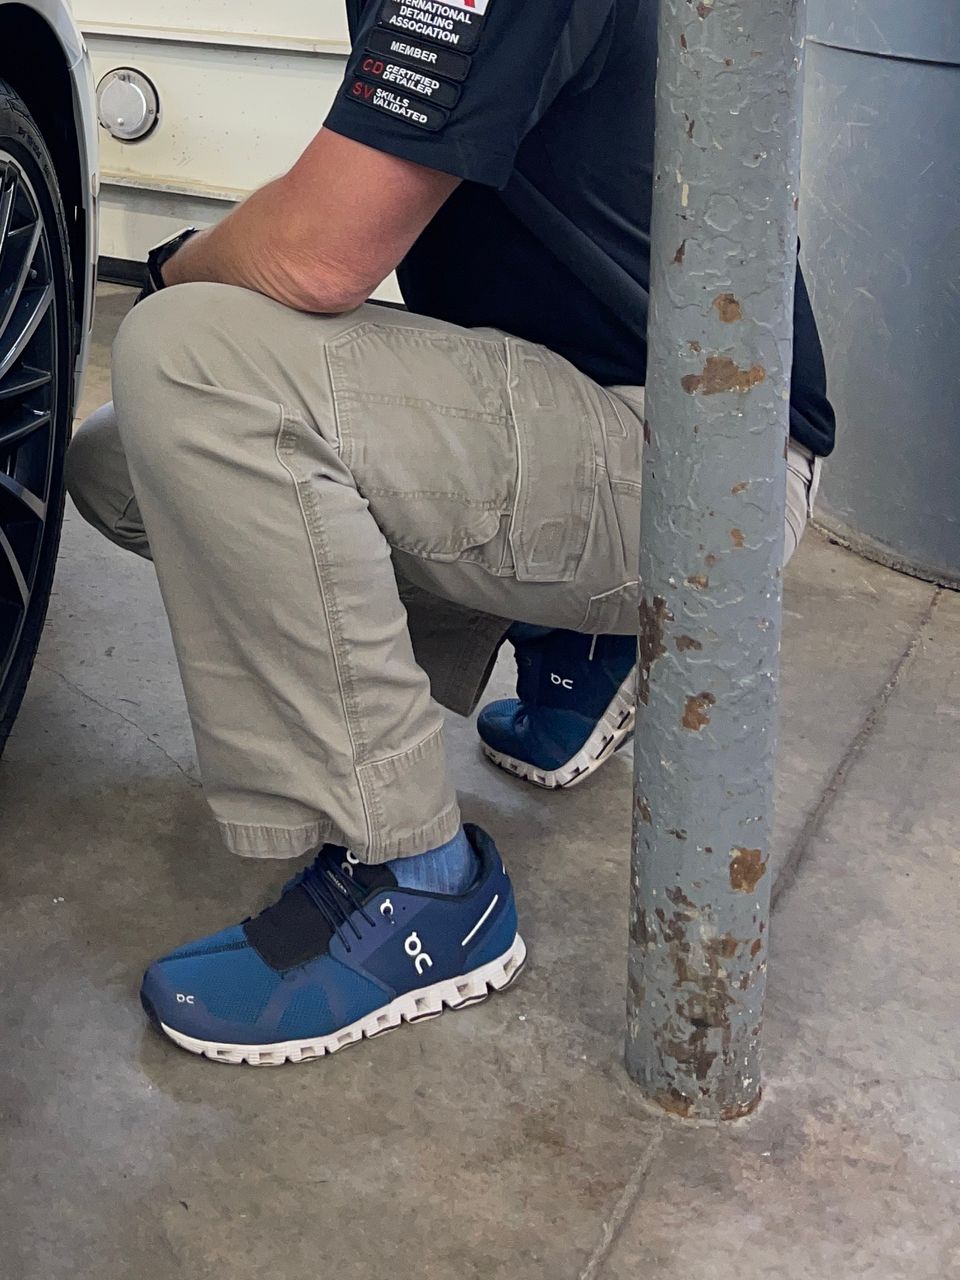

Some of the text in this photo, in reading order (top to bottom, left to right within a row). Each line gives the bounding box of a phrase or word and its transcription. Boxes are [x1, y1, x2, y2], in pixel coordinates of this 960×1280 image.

[389, 14, 460, 44] ASSOCIATION
[399, 5, 454, 30] DETAILING
[390, 40, 438, 64] MEMBER
[382, 71, 433, 96] DETAILER
[385, 63, 440, 89] CERTIFIED
[372, 95, 428, 124] VALIDATED
[375, 88, 410, 107] SKILLS
